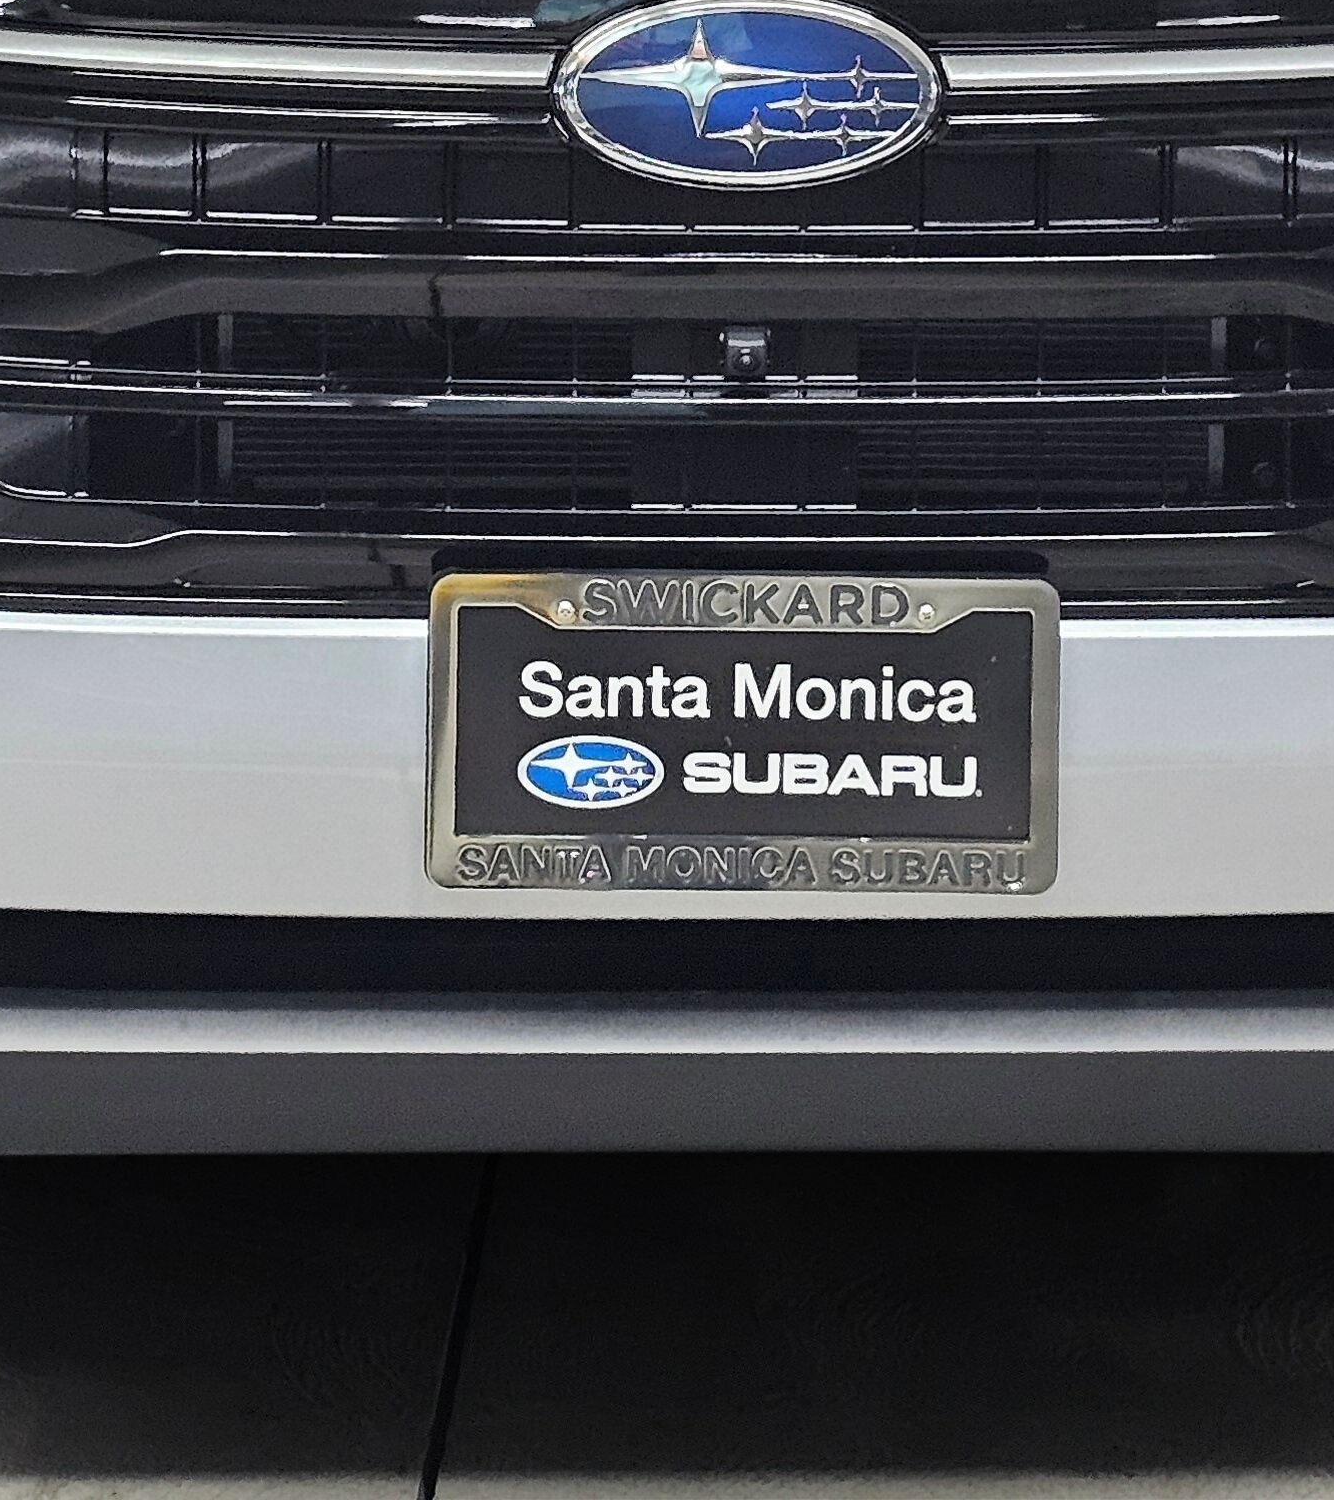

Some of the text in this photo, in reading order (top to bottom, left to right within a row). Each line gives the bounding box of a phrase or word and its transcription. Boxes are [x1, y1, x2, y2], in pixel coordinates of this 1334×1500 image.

[583, 579, 910, 626] SWICKARD
[519, 660, 977, 723] Santa Monica
[456, 844, 1027, 888] SANTA MONICA SUBARU
